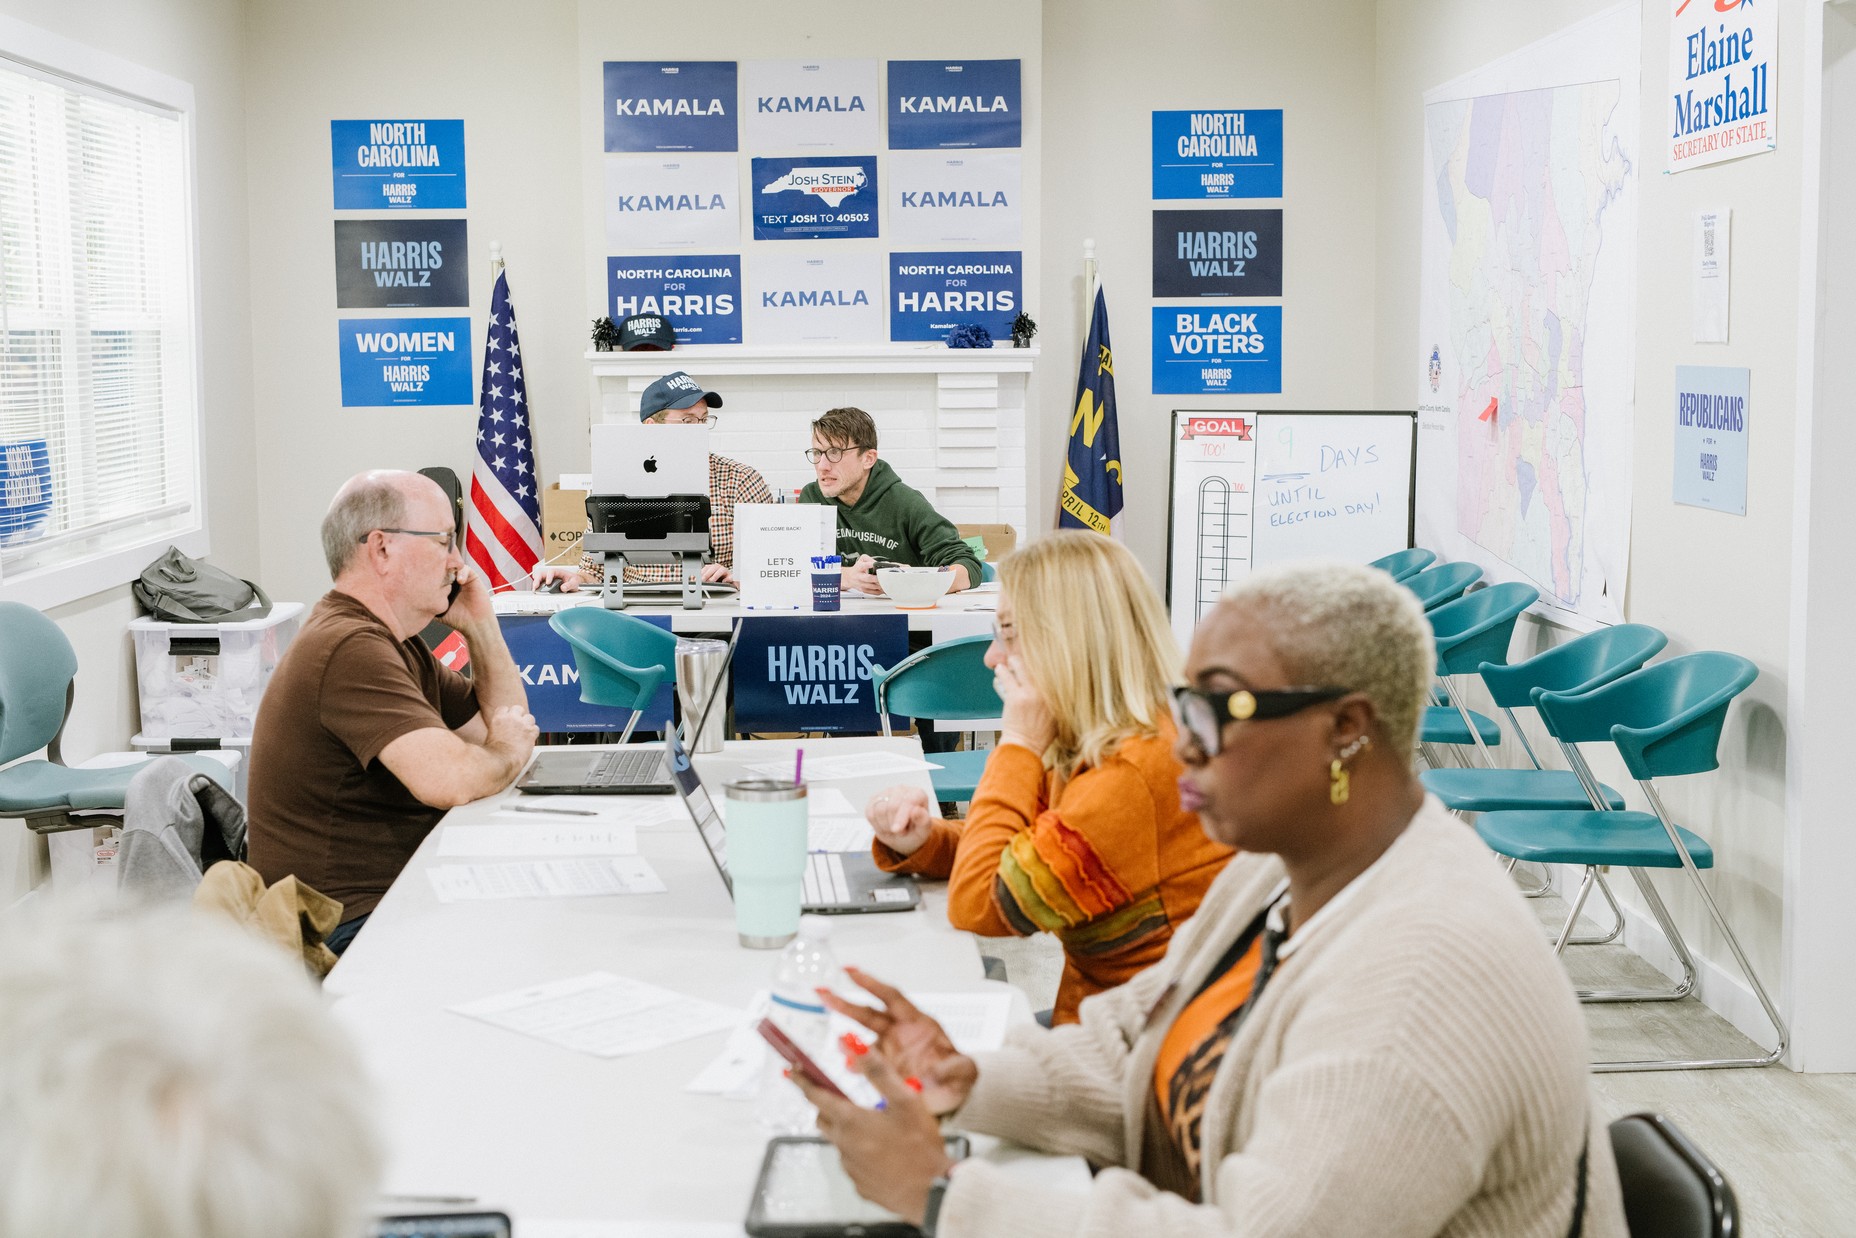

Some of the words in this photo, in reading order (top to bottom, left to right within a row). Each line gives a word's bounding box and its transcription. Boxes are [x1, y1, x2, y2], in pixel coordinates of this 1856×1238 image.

[1686, 24, 1754, 81] Elaine
[616, 98, 726, 116] KAMALA
[757, 96, 866, 113] KAMALA
[900, 96, 1009, 114] KAMALA
[1673, 62, 1768, 138] Marshall
[1190, 113, 1245, 135] NORTH
[370, 122, 426, 145] NORTH
[1673, 132, 1719, 161] SECRETARY
[1721, 130, 1734, 147] OF
[1736, 121, 1767, 143] STATE
[1177, 134, 1258, 158] CAROLINA
[357, 144, 440, 168] CAROLINA
[788, 174, 819, 186] JOSH
[822, 173, 855, 185] STEIN
[1200, 173, 1235, 186] HARRIS
[382, 184, 417, 196] HARRIS
[901, 190, 1009, 208] KAMALA
[388, 196, 412, 204] WALZ
[618, 194, 726, 212] KAMALA
[762, 215, 788, 224] TEXT
[790, 214, 817, 223] JOSH
[819, 214, 835, 223] TO
[836, 213, 870, 222] 40503
[1177, 231, 1258, 260] HARRIS
[361, 240, 443, 270] HARRIS
[616, 269, 664, 280] NORTH
[664, 267, 733, 279] CAROLINA
[898, 265, 945, 275] NORTH
[946, 264, 1014, 275] CAROLINA
[1189, 261, 1246, 277] WALZ
[374, 271, 431, 287] WALZ
[663, 282, 686, 291] FOR
[945, 279, 968, 287] FOR
[617, 293, 734, 317] HARRIS
[761, 290, 870, 308] KAMALA
[898, 289, 1015, 313] HARRIS
[627, 317, 662, 332] HARRIS
[634, 327, 657, 336] WALZ
[1176, 313, 1258, 333] BLACK
[356, 331, 455, 354] WOMEN
[1169, 334, 1265, 354] VOTERS
[383, 364, 431, 382] HARRIS
[1201, 368, 1232, 380] HARRIS
[390, 381, 424, 392] WALZ
[1071, 387, 1104, 448] N
[1679, 392, 1744, 433] REPUBLICANS
[1193, 420, 1241, 433] GOAL
[1201, 443, 1226, 457] 700!
[1278, 425, 1293, 459] 9
[1319, 444, 1379, 473] DAYS
[1705, 437, 1713, 445] FOR
[1699, 452, 1718, 472] HARRIS
[1702, 471, 1715, 482] WALZ
[1062, 486, 1082, 518] PRIL
[1267, 485, 1326, 507] UNTIL
[1270, 508, 1337, 527] ELECTION
[1345, 492, 1381, 515] DAY!
[558, 531, 584, 542] COP
[886, 539, 899, 550] OF
[767, 557, 794, 566] LET'S
[760, 569, 802, 578] DEBRIEF
[767, 643, 875, 682] HARRIS
[784, 683, 860, 705] WALZ
